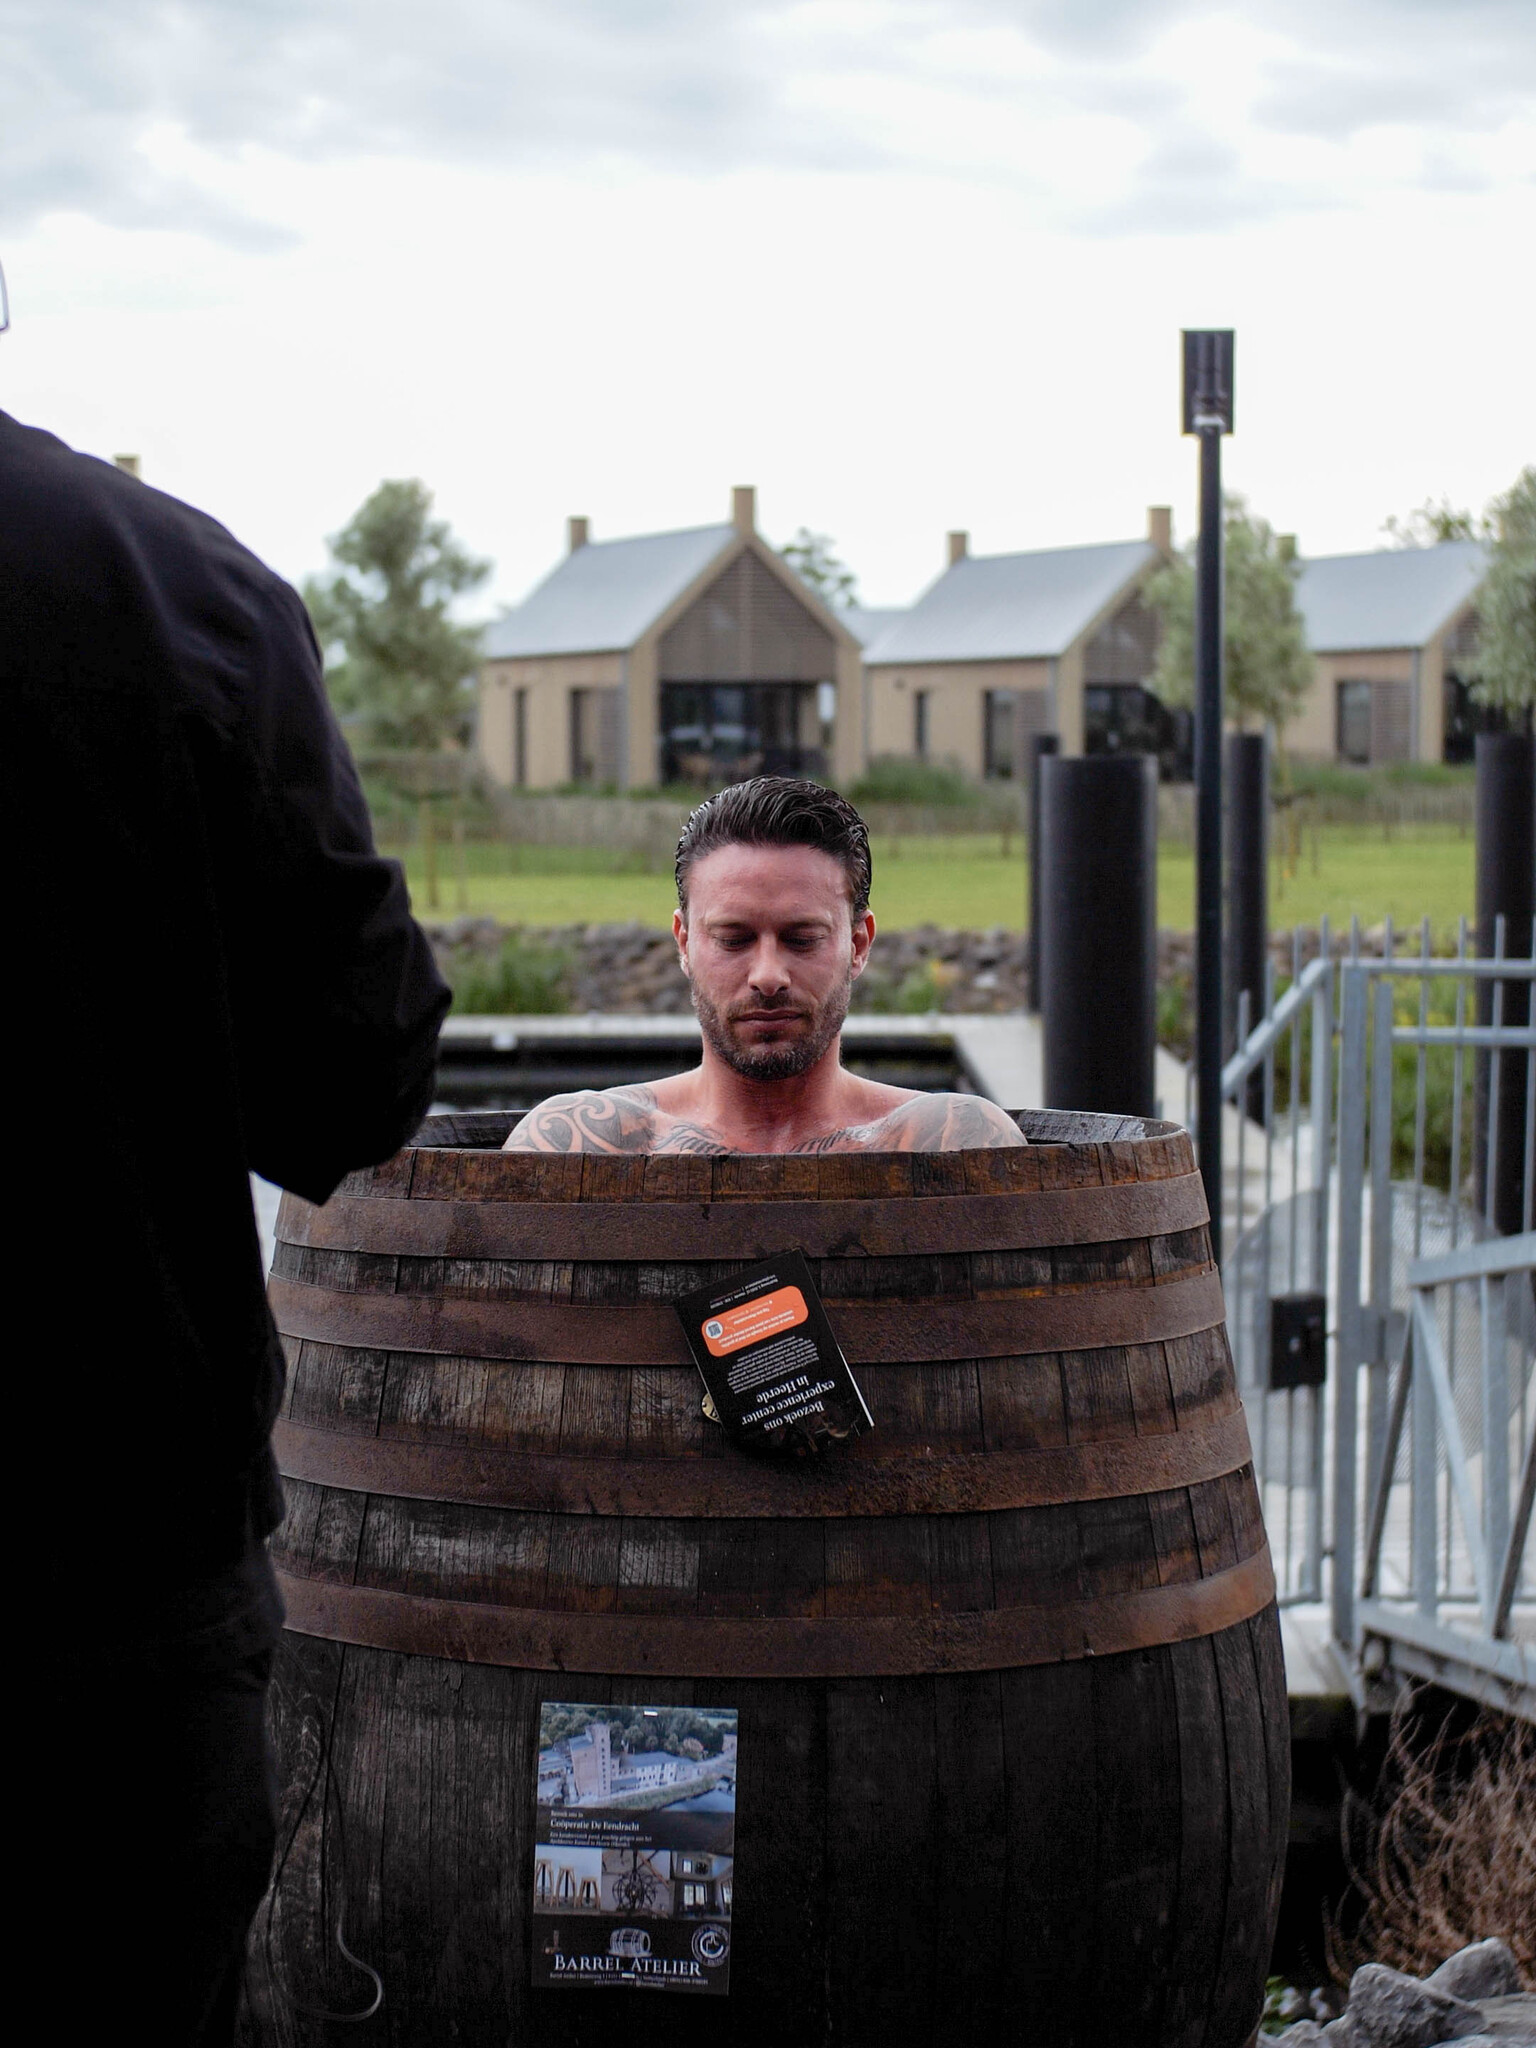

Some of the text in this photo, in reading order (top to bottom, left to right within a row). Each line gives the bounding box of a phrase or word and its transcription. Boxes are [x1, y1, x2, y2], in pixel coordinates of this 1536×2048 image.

[741, 1380, 836, 1426] experience center
[756, 1374, 810, 1403] in Heerde
[763, 1400, 825, 1431] Bezoek ons
[591, 1820, 601, 1830] De
[603, 1822, 639, 1831] Eendracht
[554, 1953, 702, 1977] BARREL ATELIER
